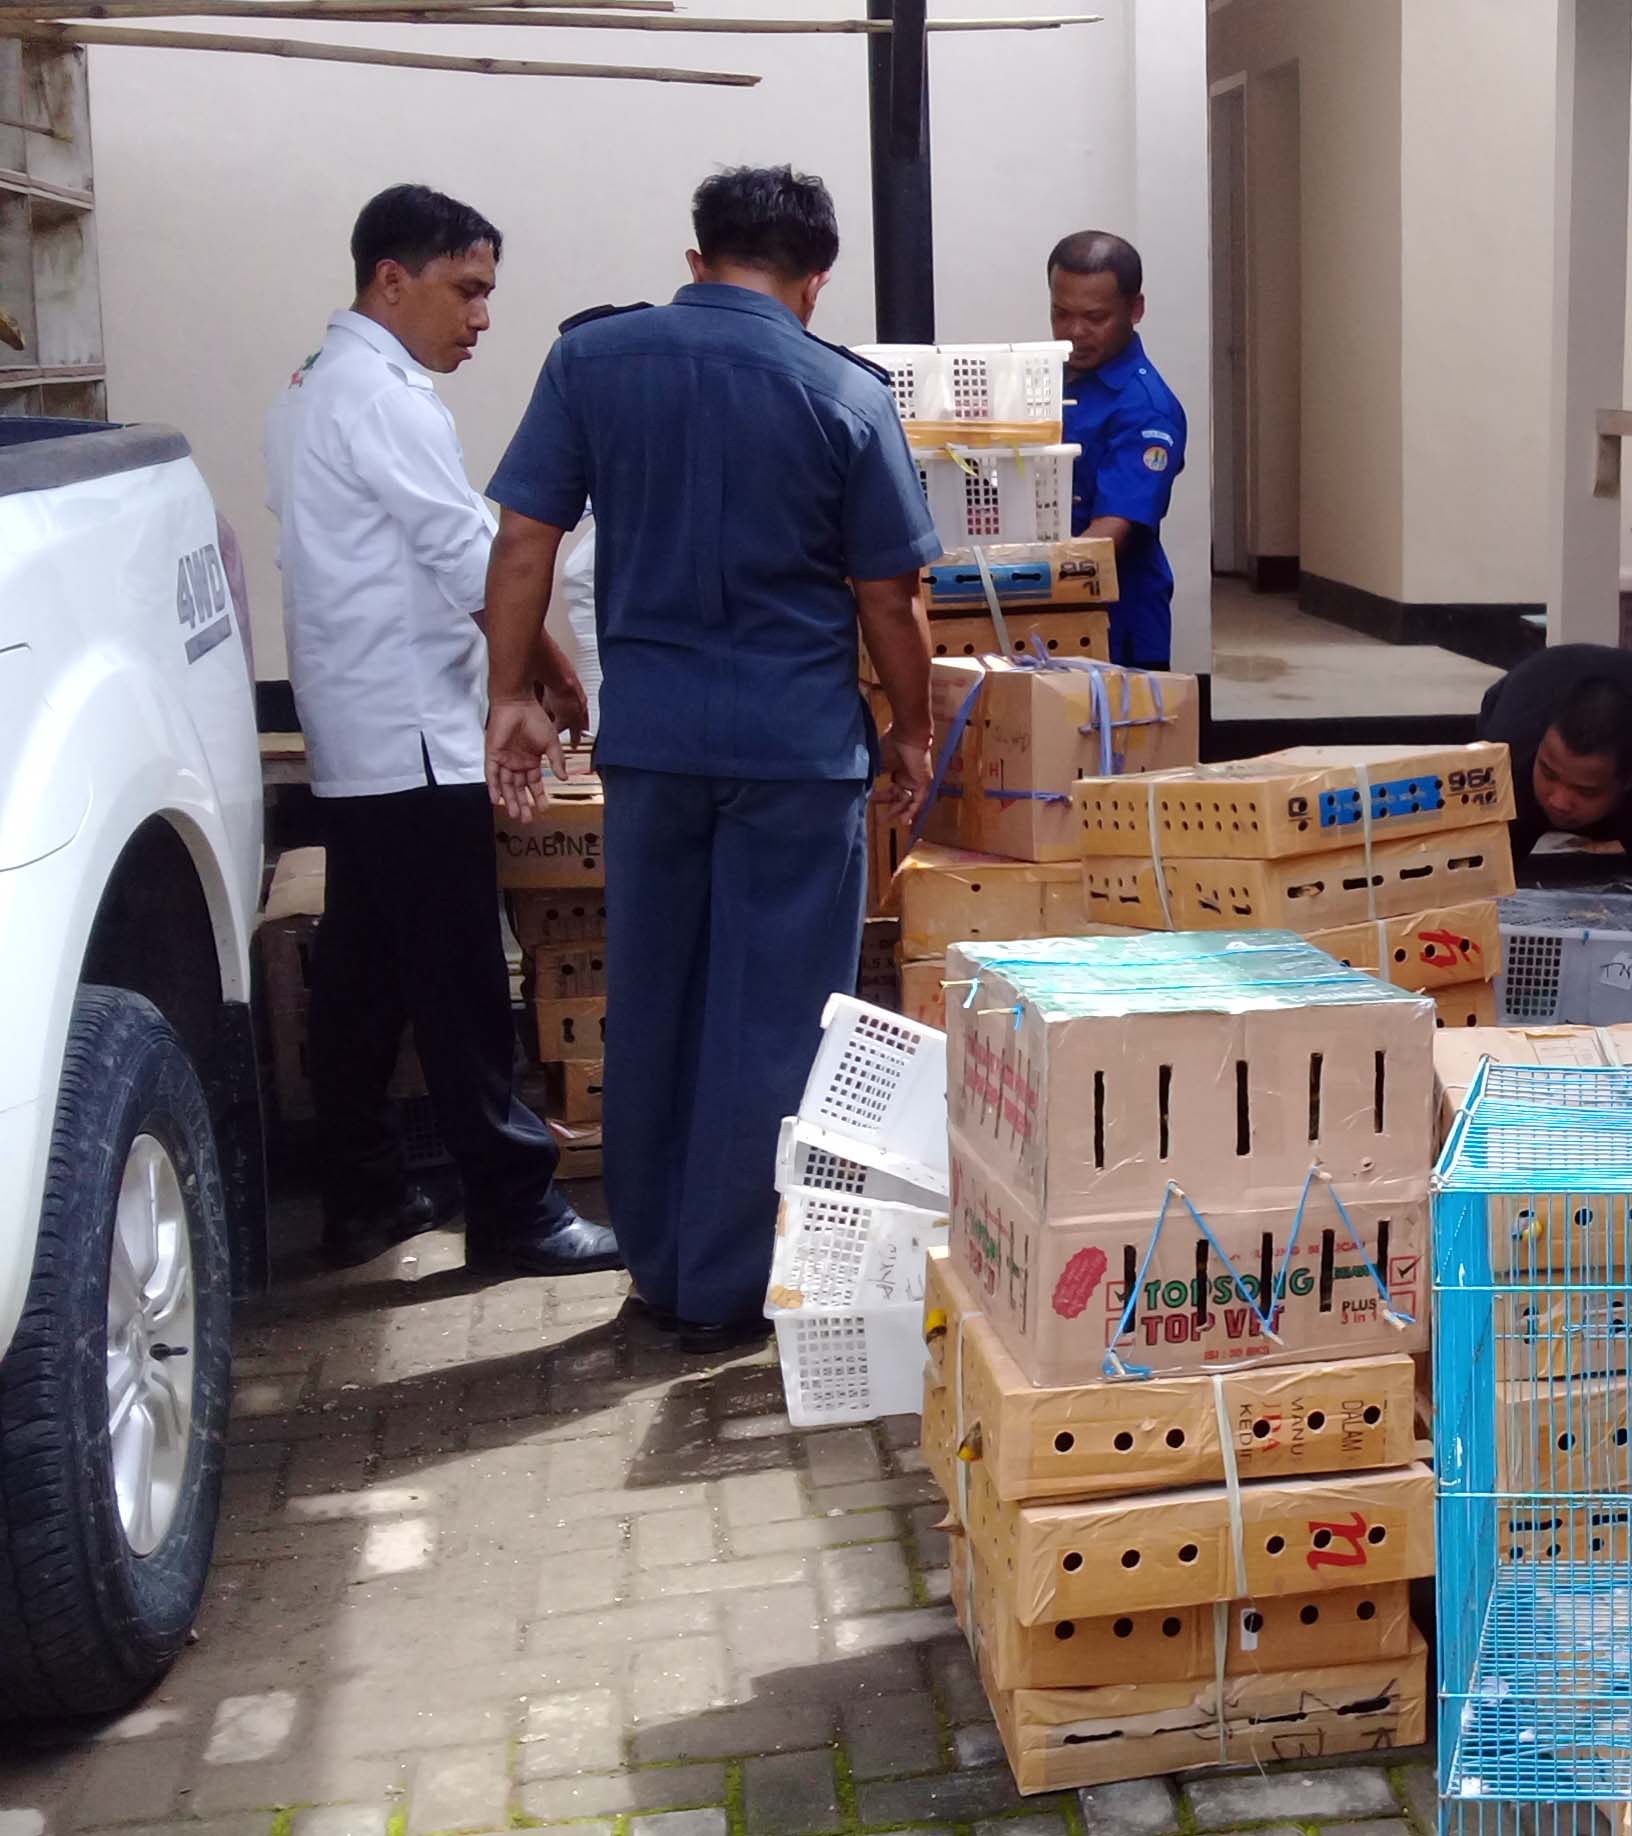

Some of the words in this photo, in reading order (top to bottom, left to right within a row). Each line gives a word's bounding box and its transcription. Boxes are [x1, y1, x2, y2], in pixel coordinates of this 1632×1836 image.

[176, 543, 226, 629] 4WD
[1342, 1298, 1377, 1313] PLUS
[1140, 1311, 1216, 1347] TOP
[1342, 1400, 1364, 1451] DALAM
